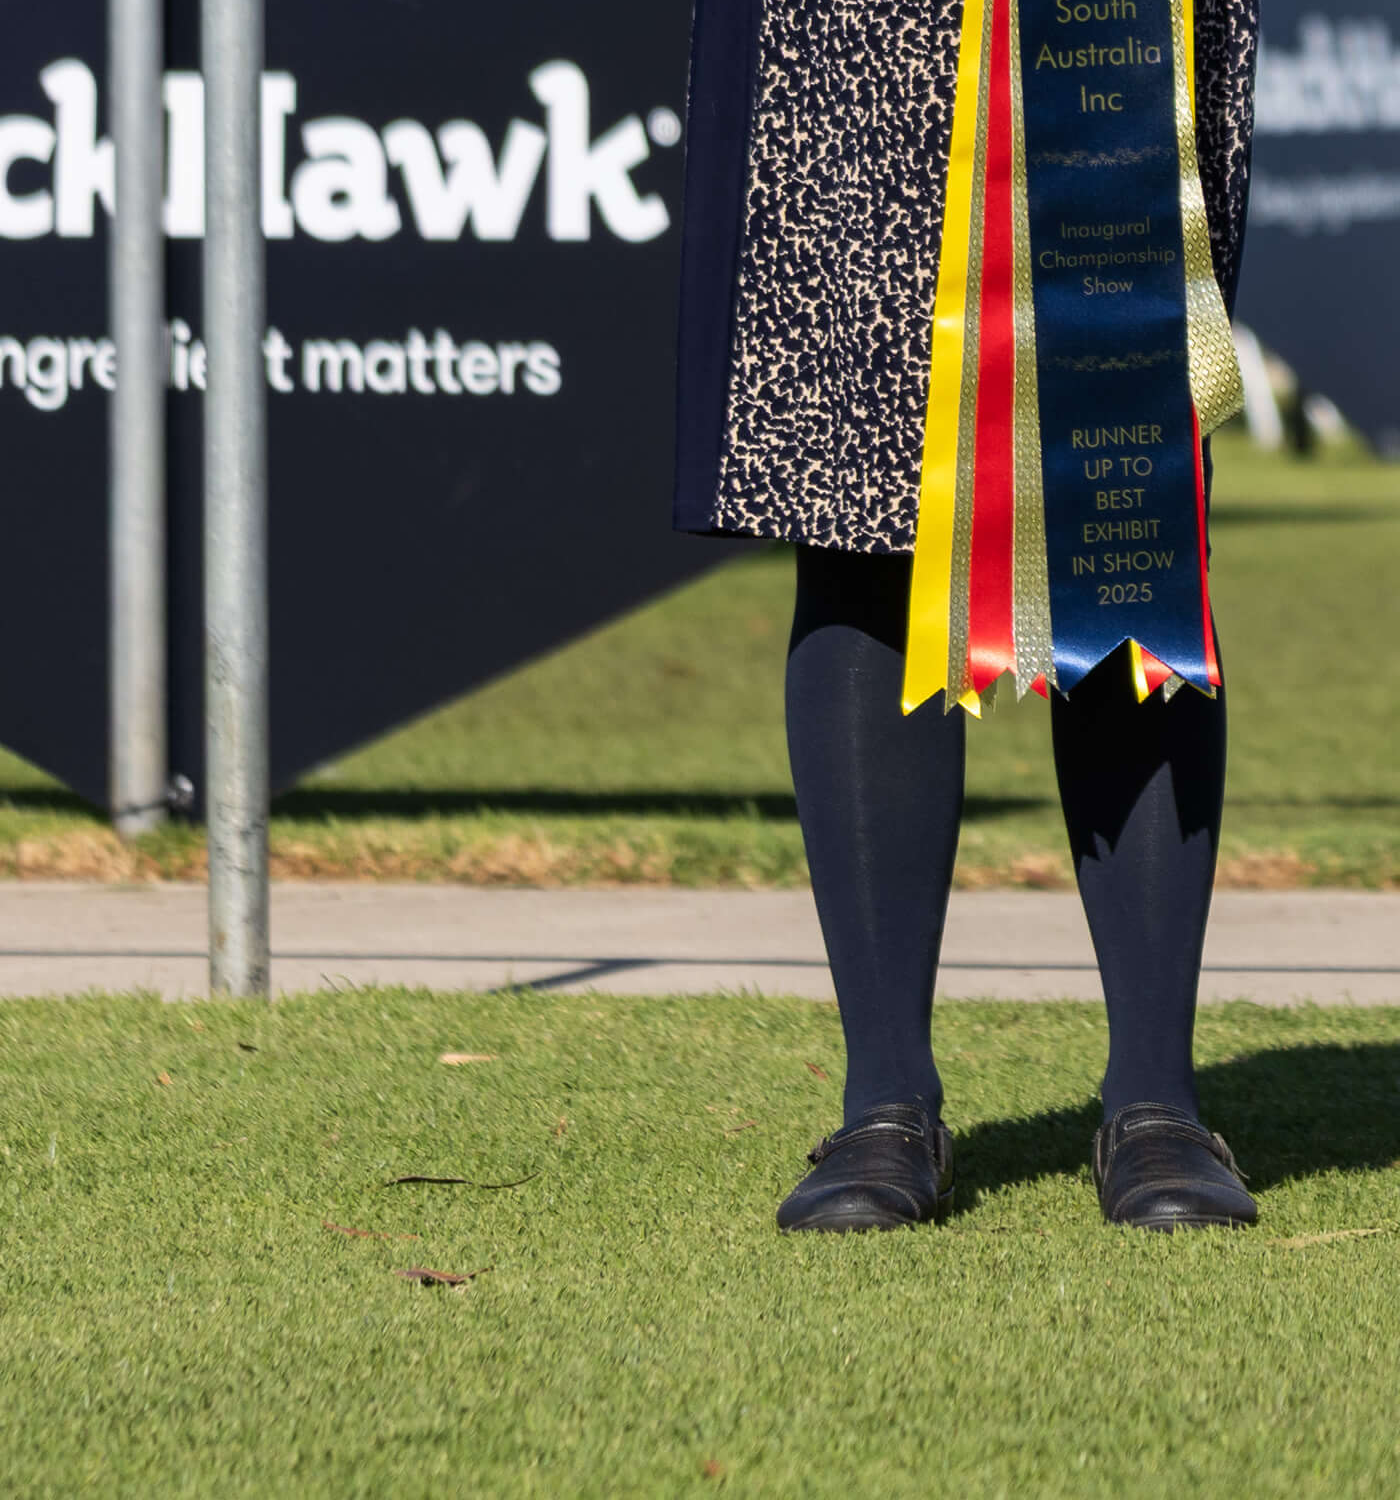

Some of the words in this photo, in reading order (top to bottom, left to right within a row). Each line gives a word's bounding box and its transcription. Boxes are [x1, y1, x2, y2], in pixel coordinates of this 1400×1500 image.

[1034, 36, 1162, 71] Australia
[1080, 85, 1124, 113] Inc
[1060, 216, 1151, 240] Inaugural
[1039, 245, 1176, 270] Championship
[1082, 276, 1134, 296] Show
[302, 326, 562, 396] matters
[1071, 424, 1164, 449] RUNNER
[1084, 458, 1113, 480] UP
[1119, 456, 1153, 477] TO
[1096, 488, 1145, 510] BEST
[1083, 519, 1161, 544] EXHIBIT
[1072, 555, 1095, 576] IN
[1103, 550, 1175, 573] SHOW
[1097, 582, 1153, 605] 2025
